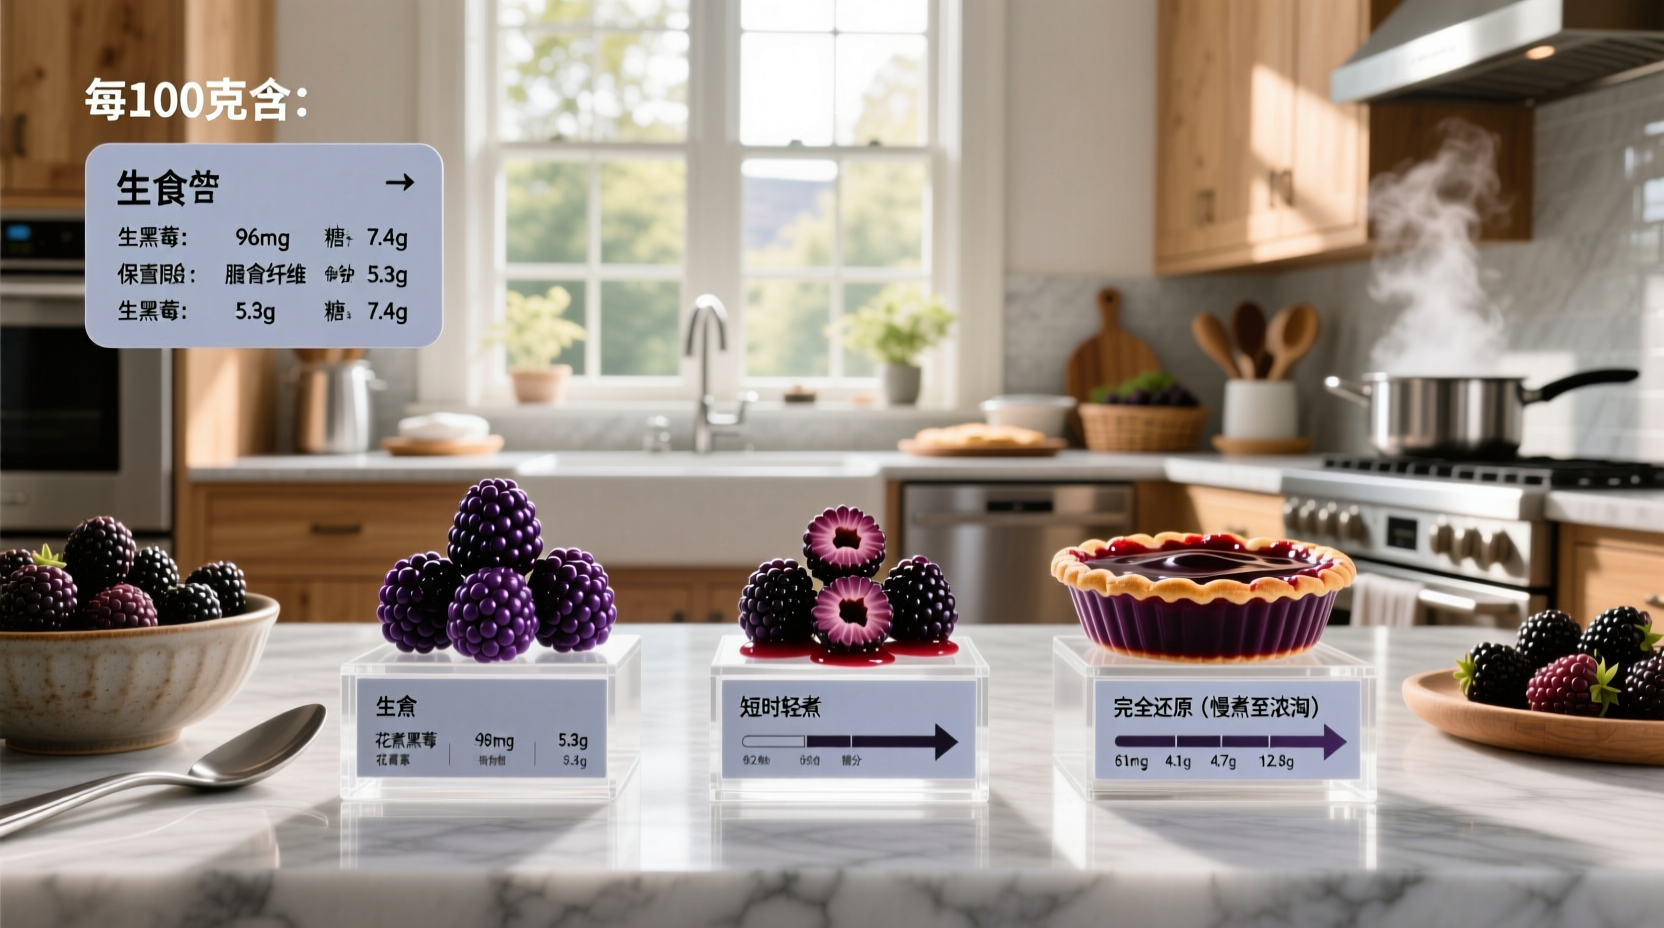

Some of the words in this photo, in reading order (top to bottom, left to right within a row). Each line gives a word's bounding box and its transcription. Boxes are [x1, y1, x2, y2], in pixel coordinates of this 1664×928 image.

[739, 695, 822, 718] 短时轻煮
[558, 732, 589, 751] 5.3g
[1210, 754, 1237, 771] 4.7g
